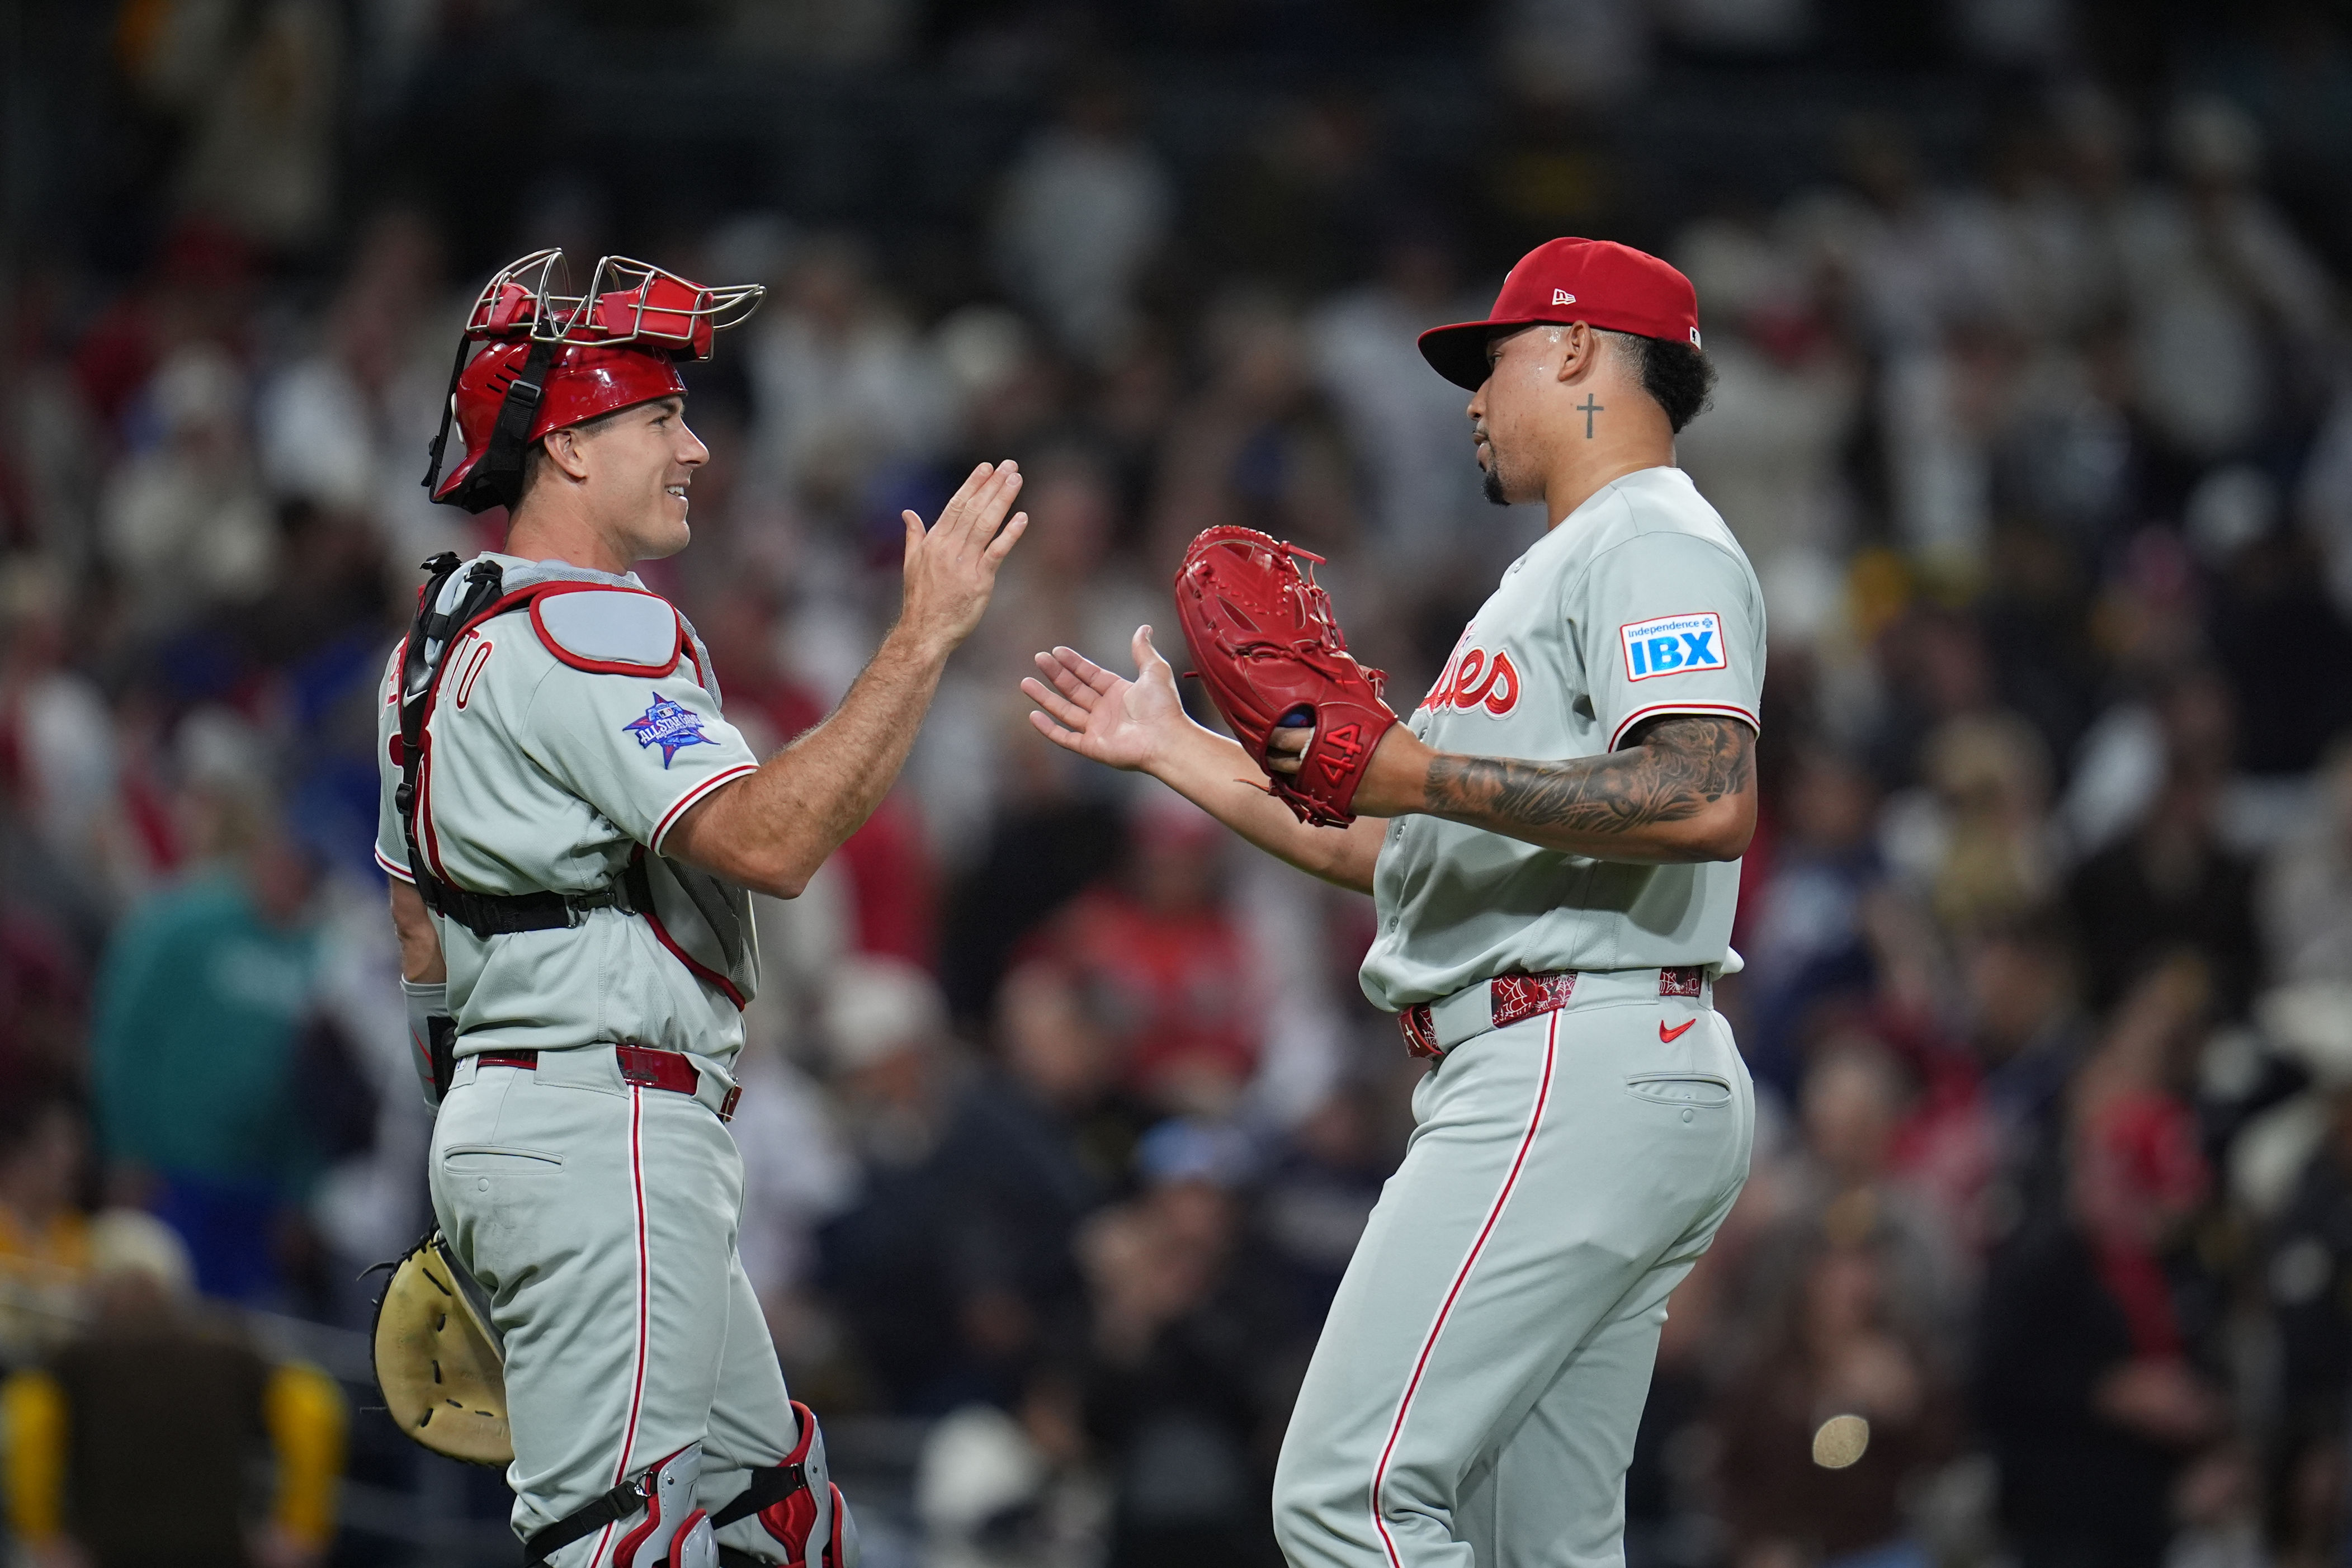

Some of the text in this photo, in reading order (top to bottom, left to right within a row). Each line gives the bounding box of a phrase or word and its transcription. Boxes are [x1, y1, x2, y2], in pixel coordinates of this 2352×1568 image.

[1628, 621, 1699, 637] Independence
[1631, 631, 1718, 676] IBX
[639, 725, 661, 744] ALL
[656, 716, 681, 732] STAR
[1316, 723, 1363, 787] 44
